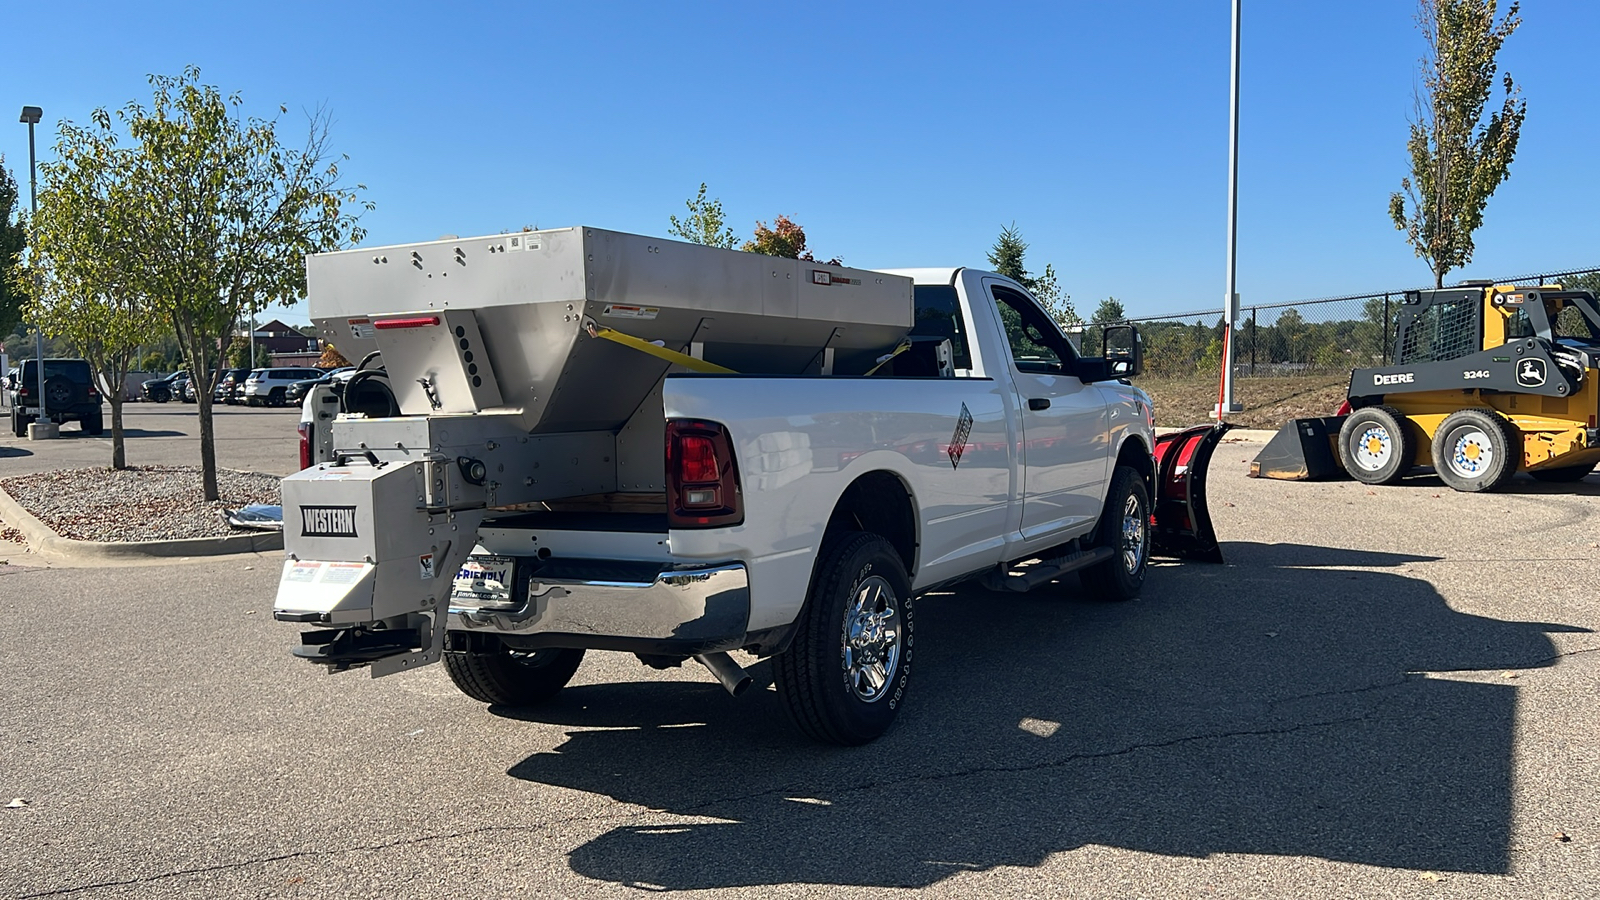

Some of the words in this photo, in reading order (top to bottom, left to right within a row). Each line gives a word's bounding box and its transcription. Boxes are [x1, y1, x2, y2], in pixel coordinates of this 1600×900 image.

[1373, 373, 1414, 385] DEERE
[1463, 370, 1490, 380] 324G
[303, 509, 354, 533] WESTERN
[456, 569, 506, 584] FRIENDLY
